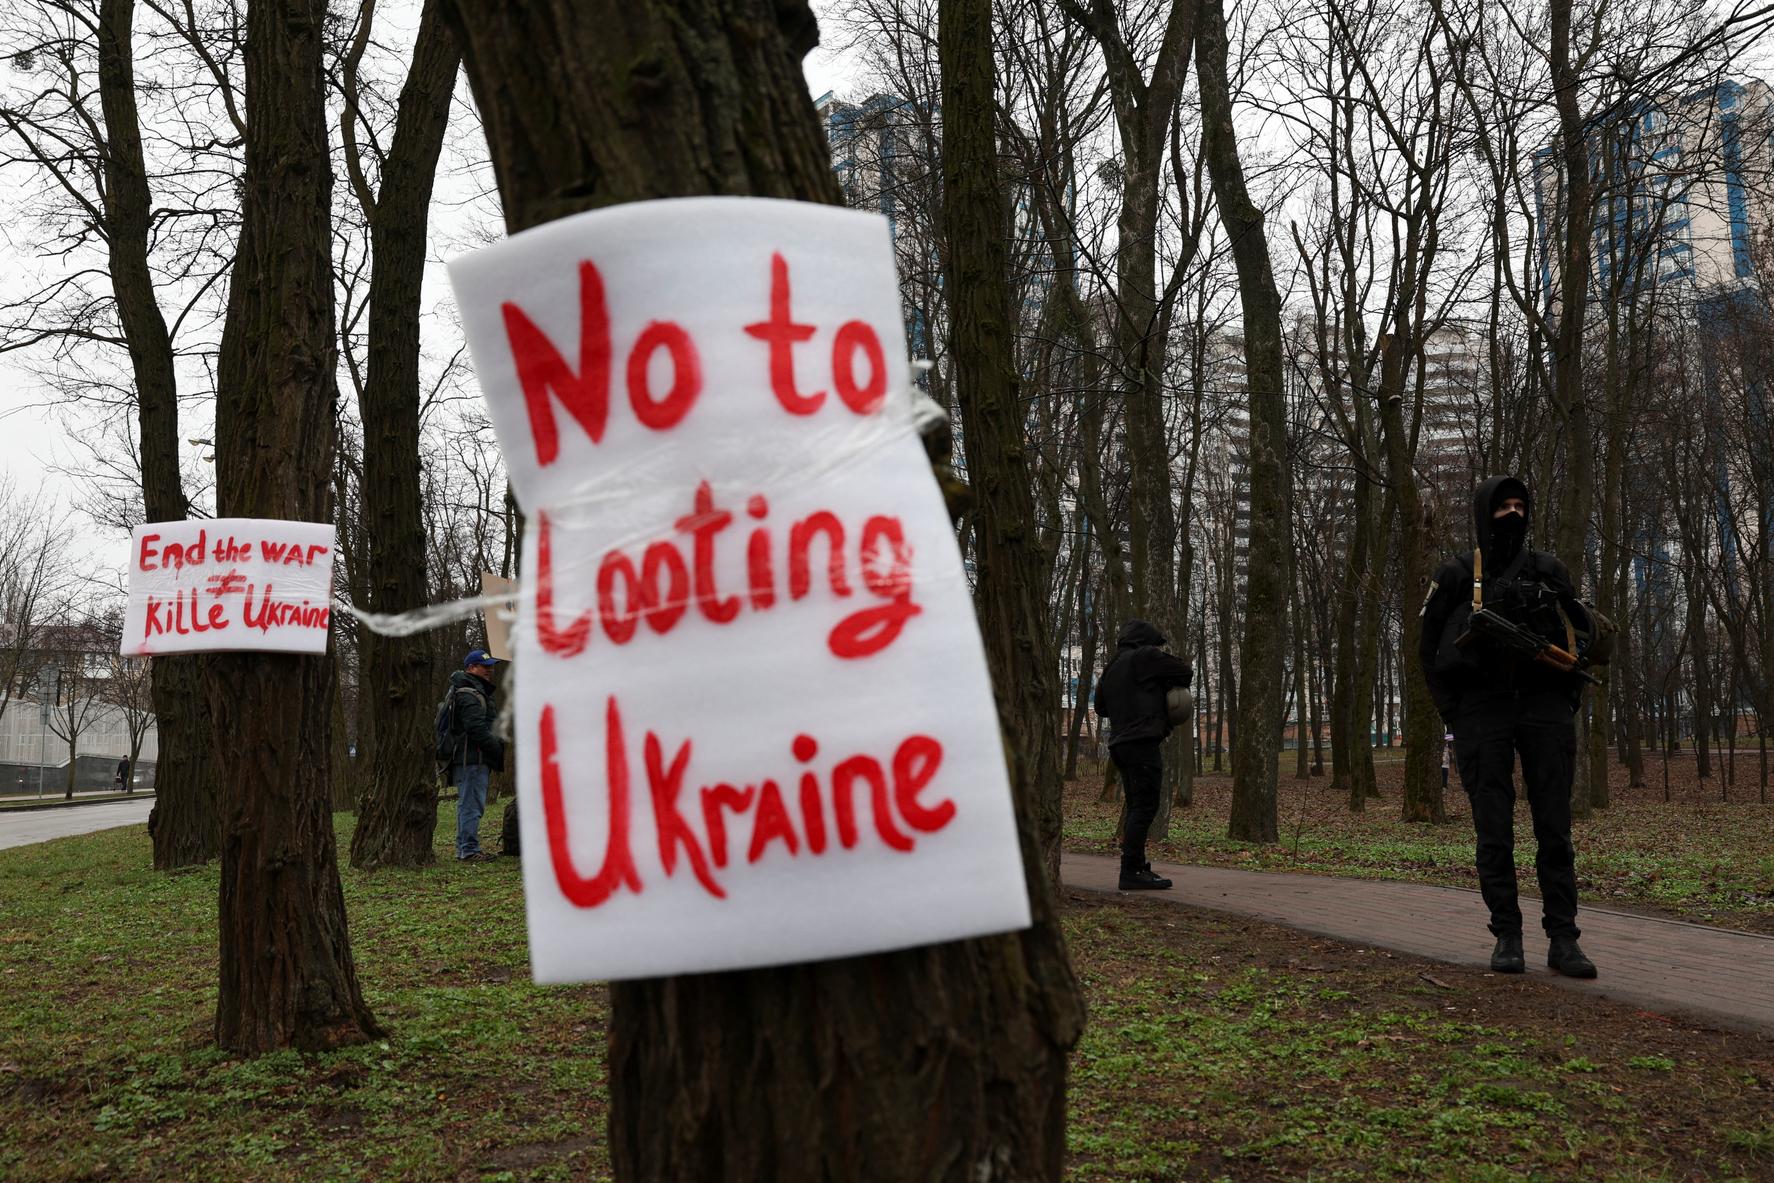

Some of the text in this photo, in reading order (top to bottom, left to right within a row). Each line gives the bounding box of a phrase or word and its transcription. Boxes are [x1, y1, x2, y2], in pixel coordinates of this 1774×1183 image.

[500, 250, 889, 468] No to
[138, 528, 207, 573] End
[211, 535, 253, 563] the
[535, 480, 924, 661] Looting
